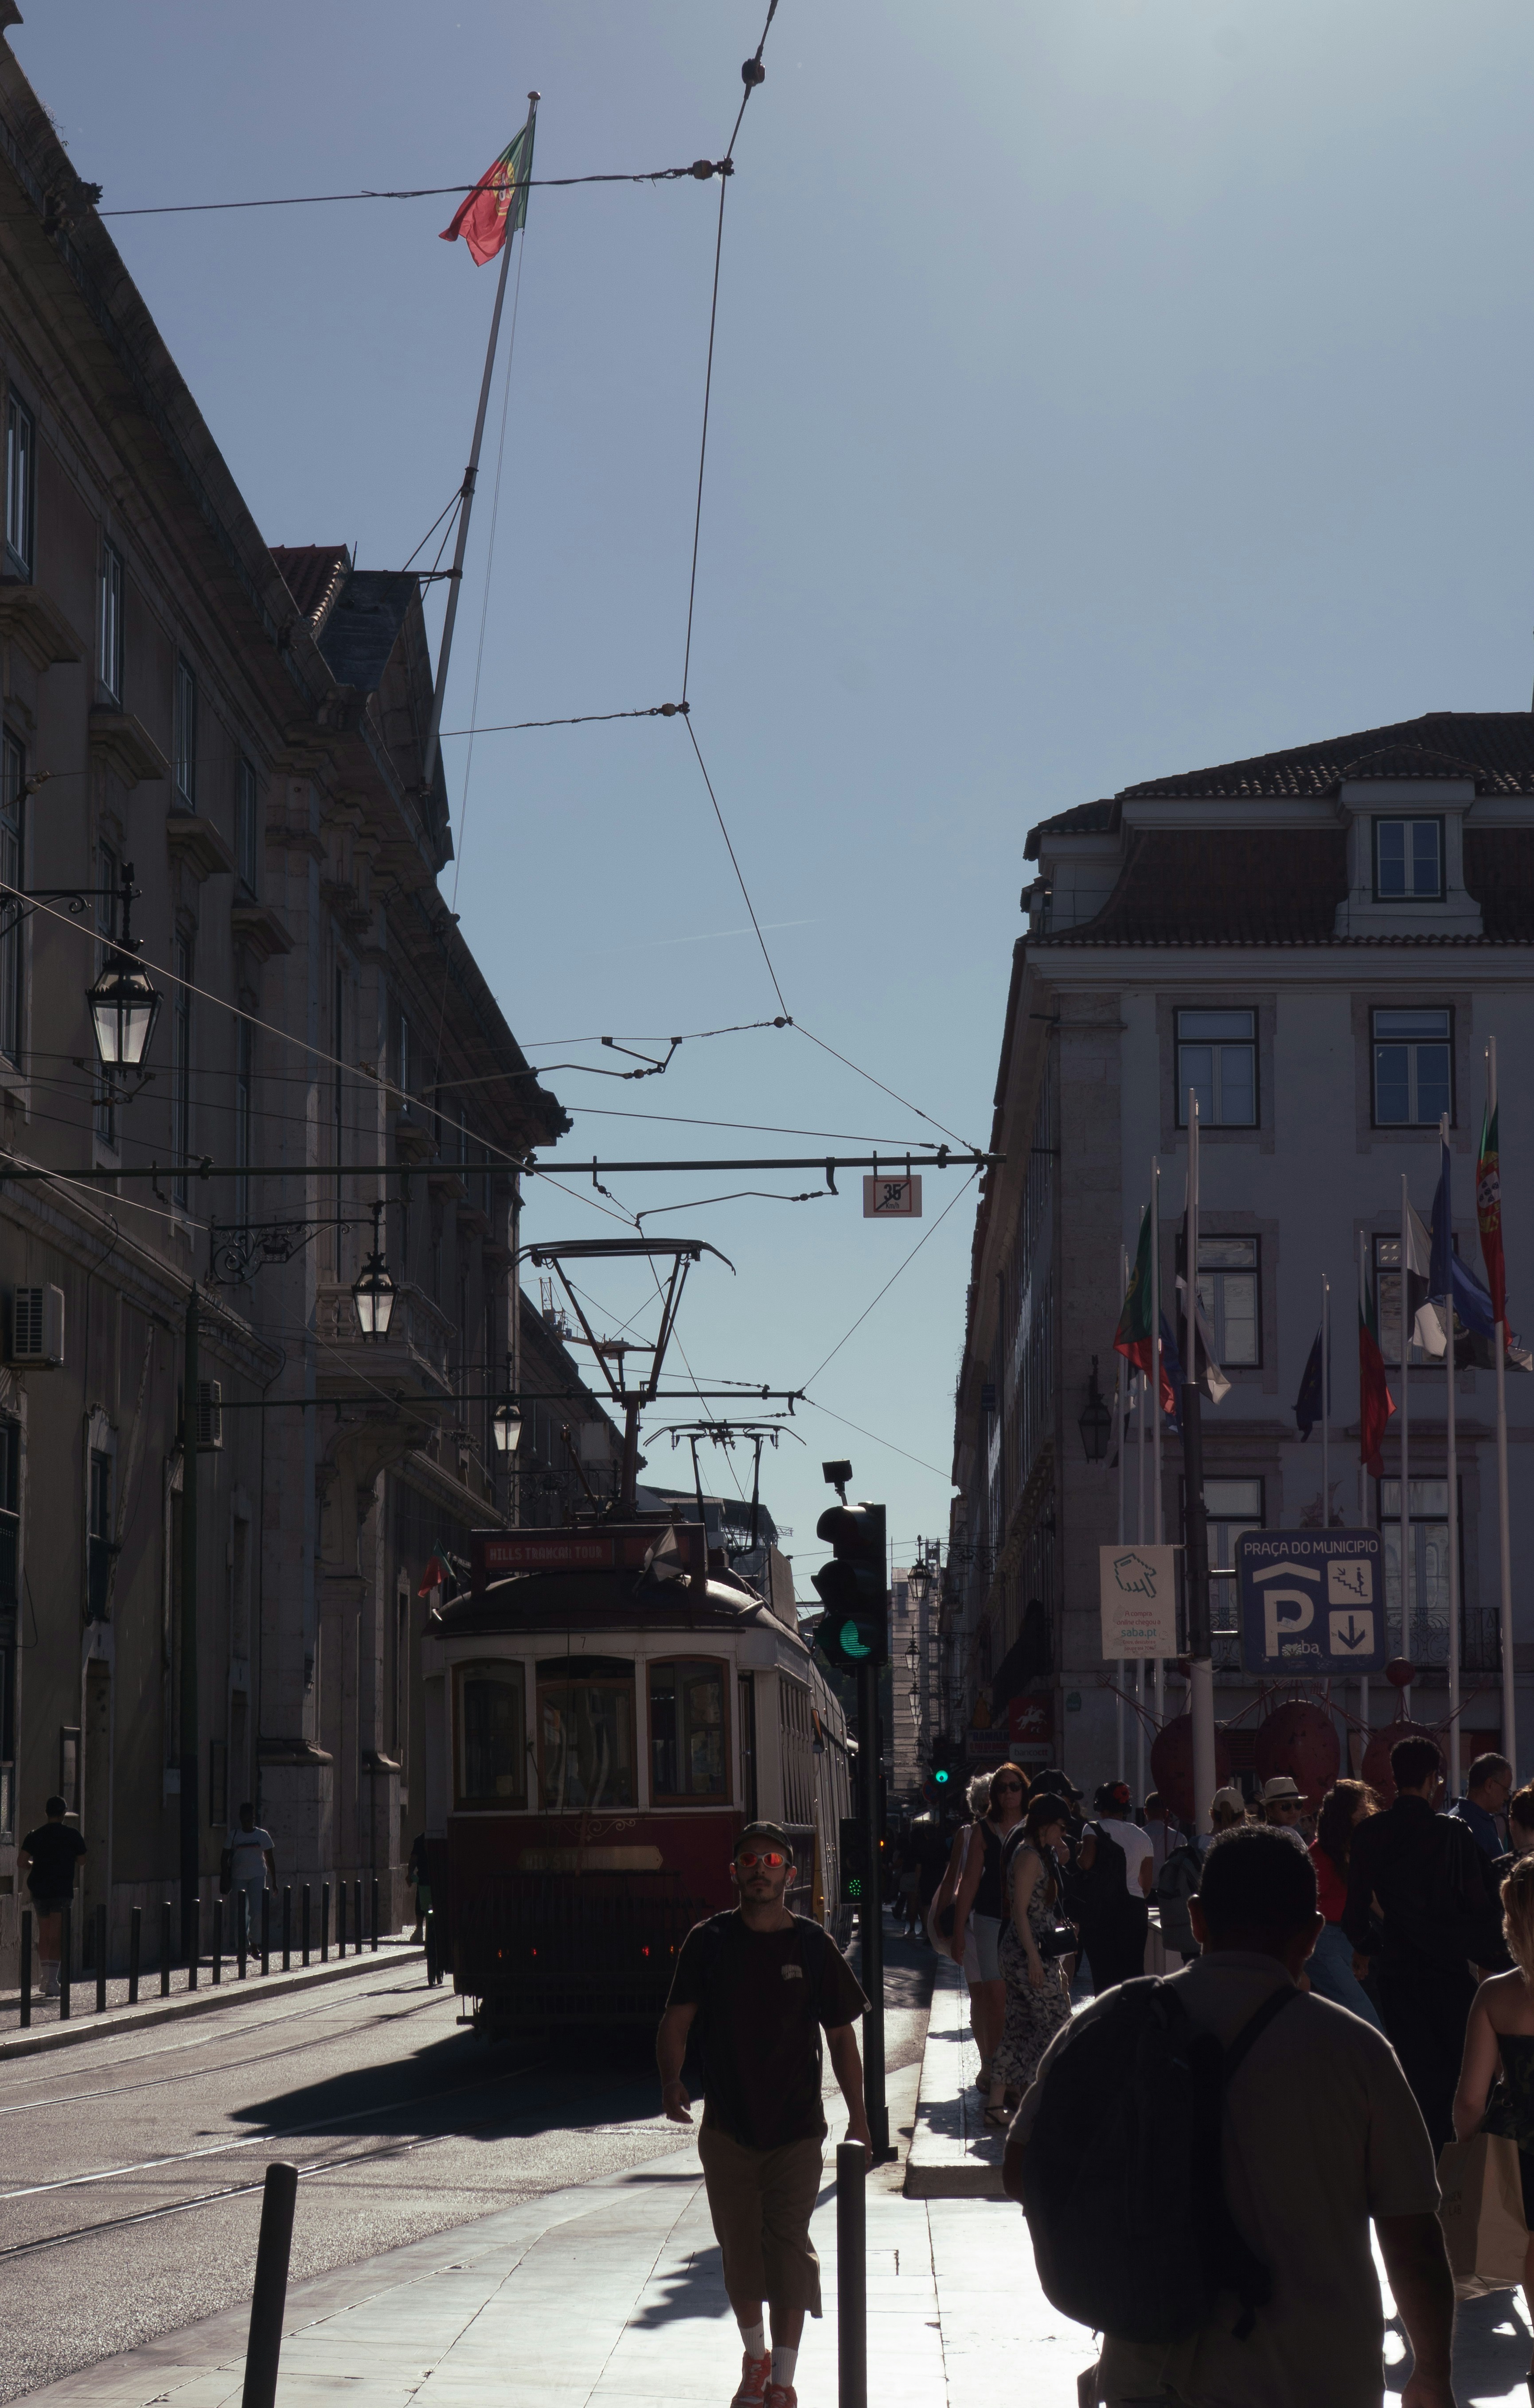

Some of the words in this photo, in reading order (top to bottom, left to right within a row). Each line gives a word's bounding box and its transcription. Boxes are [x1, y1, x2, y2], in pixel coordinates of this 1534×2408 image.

[883, 1183, 901, 1201] 35
[490, 1547, 522, 1561] HILLS
[525, 1546, 572, 1560] TRAMCAR
[574, 1545, 603, 1559] TOUR
[1244, 1542, 1288, 1557] PRAÇA
[1291, 1541, 1311, 1554] DO
[1313, 1540, 1378, 1553] MUNICIPIO
[1264, 1589, 1314, 1657] P
[1121, 1627, 1157, 1639] saba.pt
[581, 1636, 585, 1648] 7
